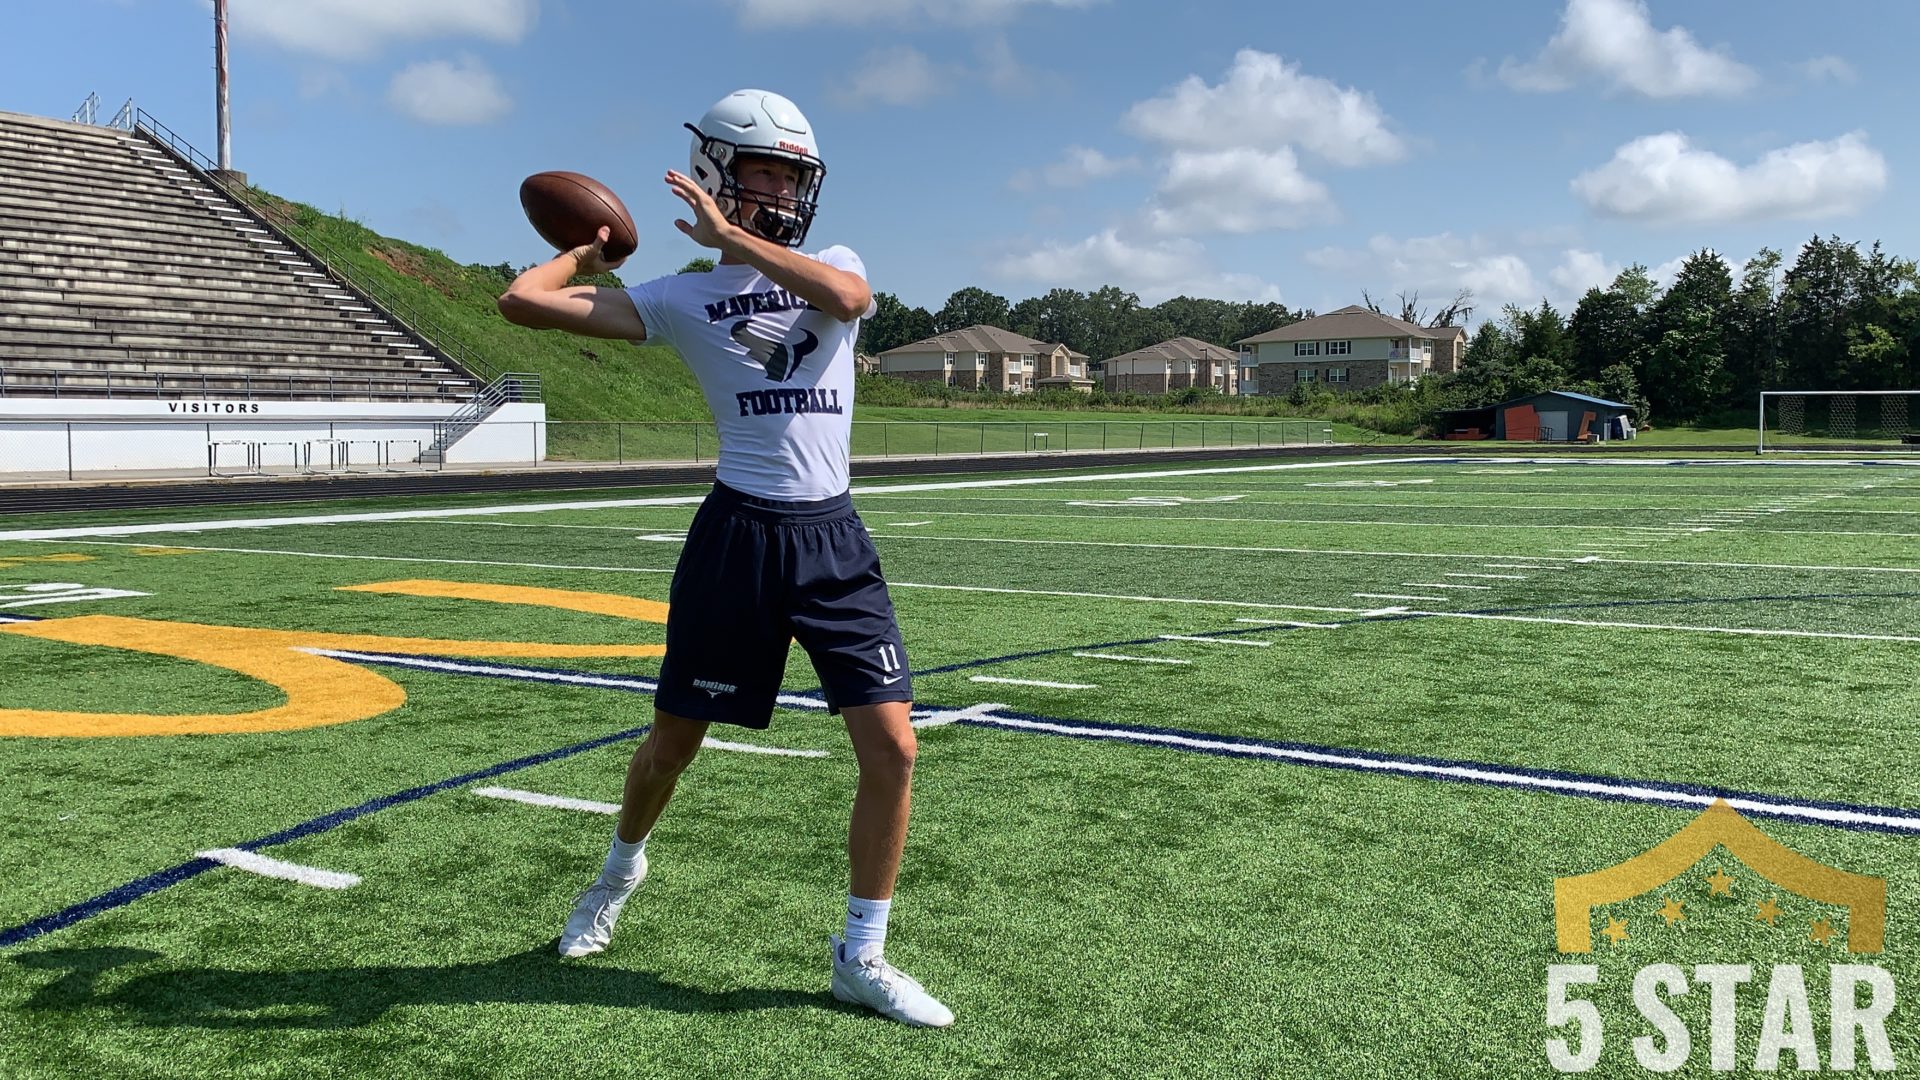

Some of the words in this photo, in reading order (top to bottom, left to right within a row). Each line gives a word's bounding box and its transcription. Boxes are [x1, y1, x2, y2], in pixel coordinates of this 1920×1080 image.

[779, 140, 809, 155] Riddell
[703, 289, 823, 323] MAVERIC
[168, 402, 259, 413] VISITORS
[735, 387, 843, 417] FOOTBALL
[878, 643, 901, 672] 11
